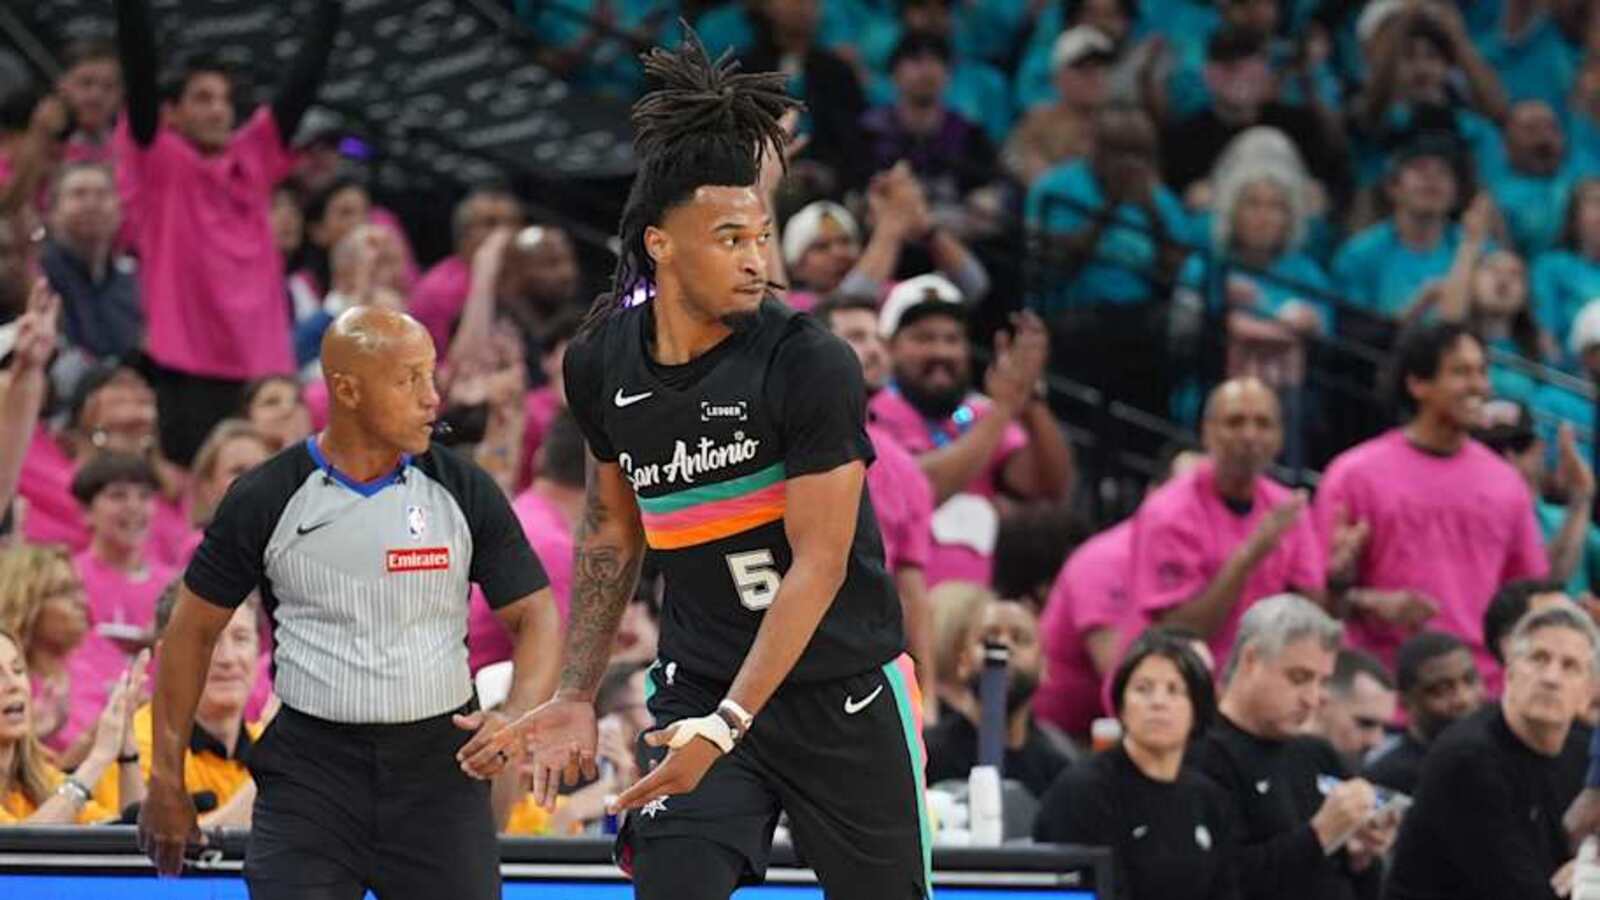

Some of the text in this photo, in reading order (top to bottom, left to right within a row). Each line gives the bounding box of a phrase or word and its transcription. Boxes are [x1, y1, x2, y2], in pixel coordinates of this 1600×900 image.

[706, 406, 741, 416] LEDGER
[663, 431, 760, 483] Antonio
[388, 550, 449, 569] Emirates
[725, 548, 780, 611] 5
